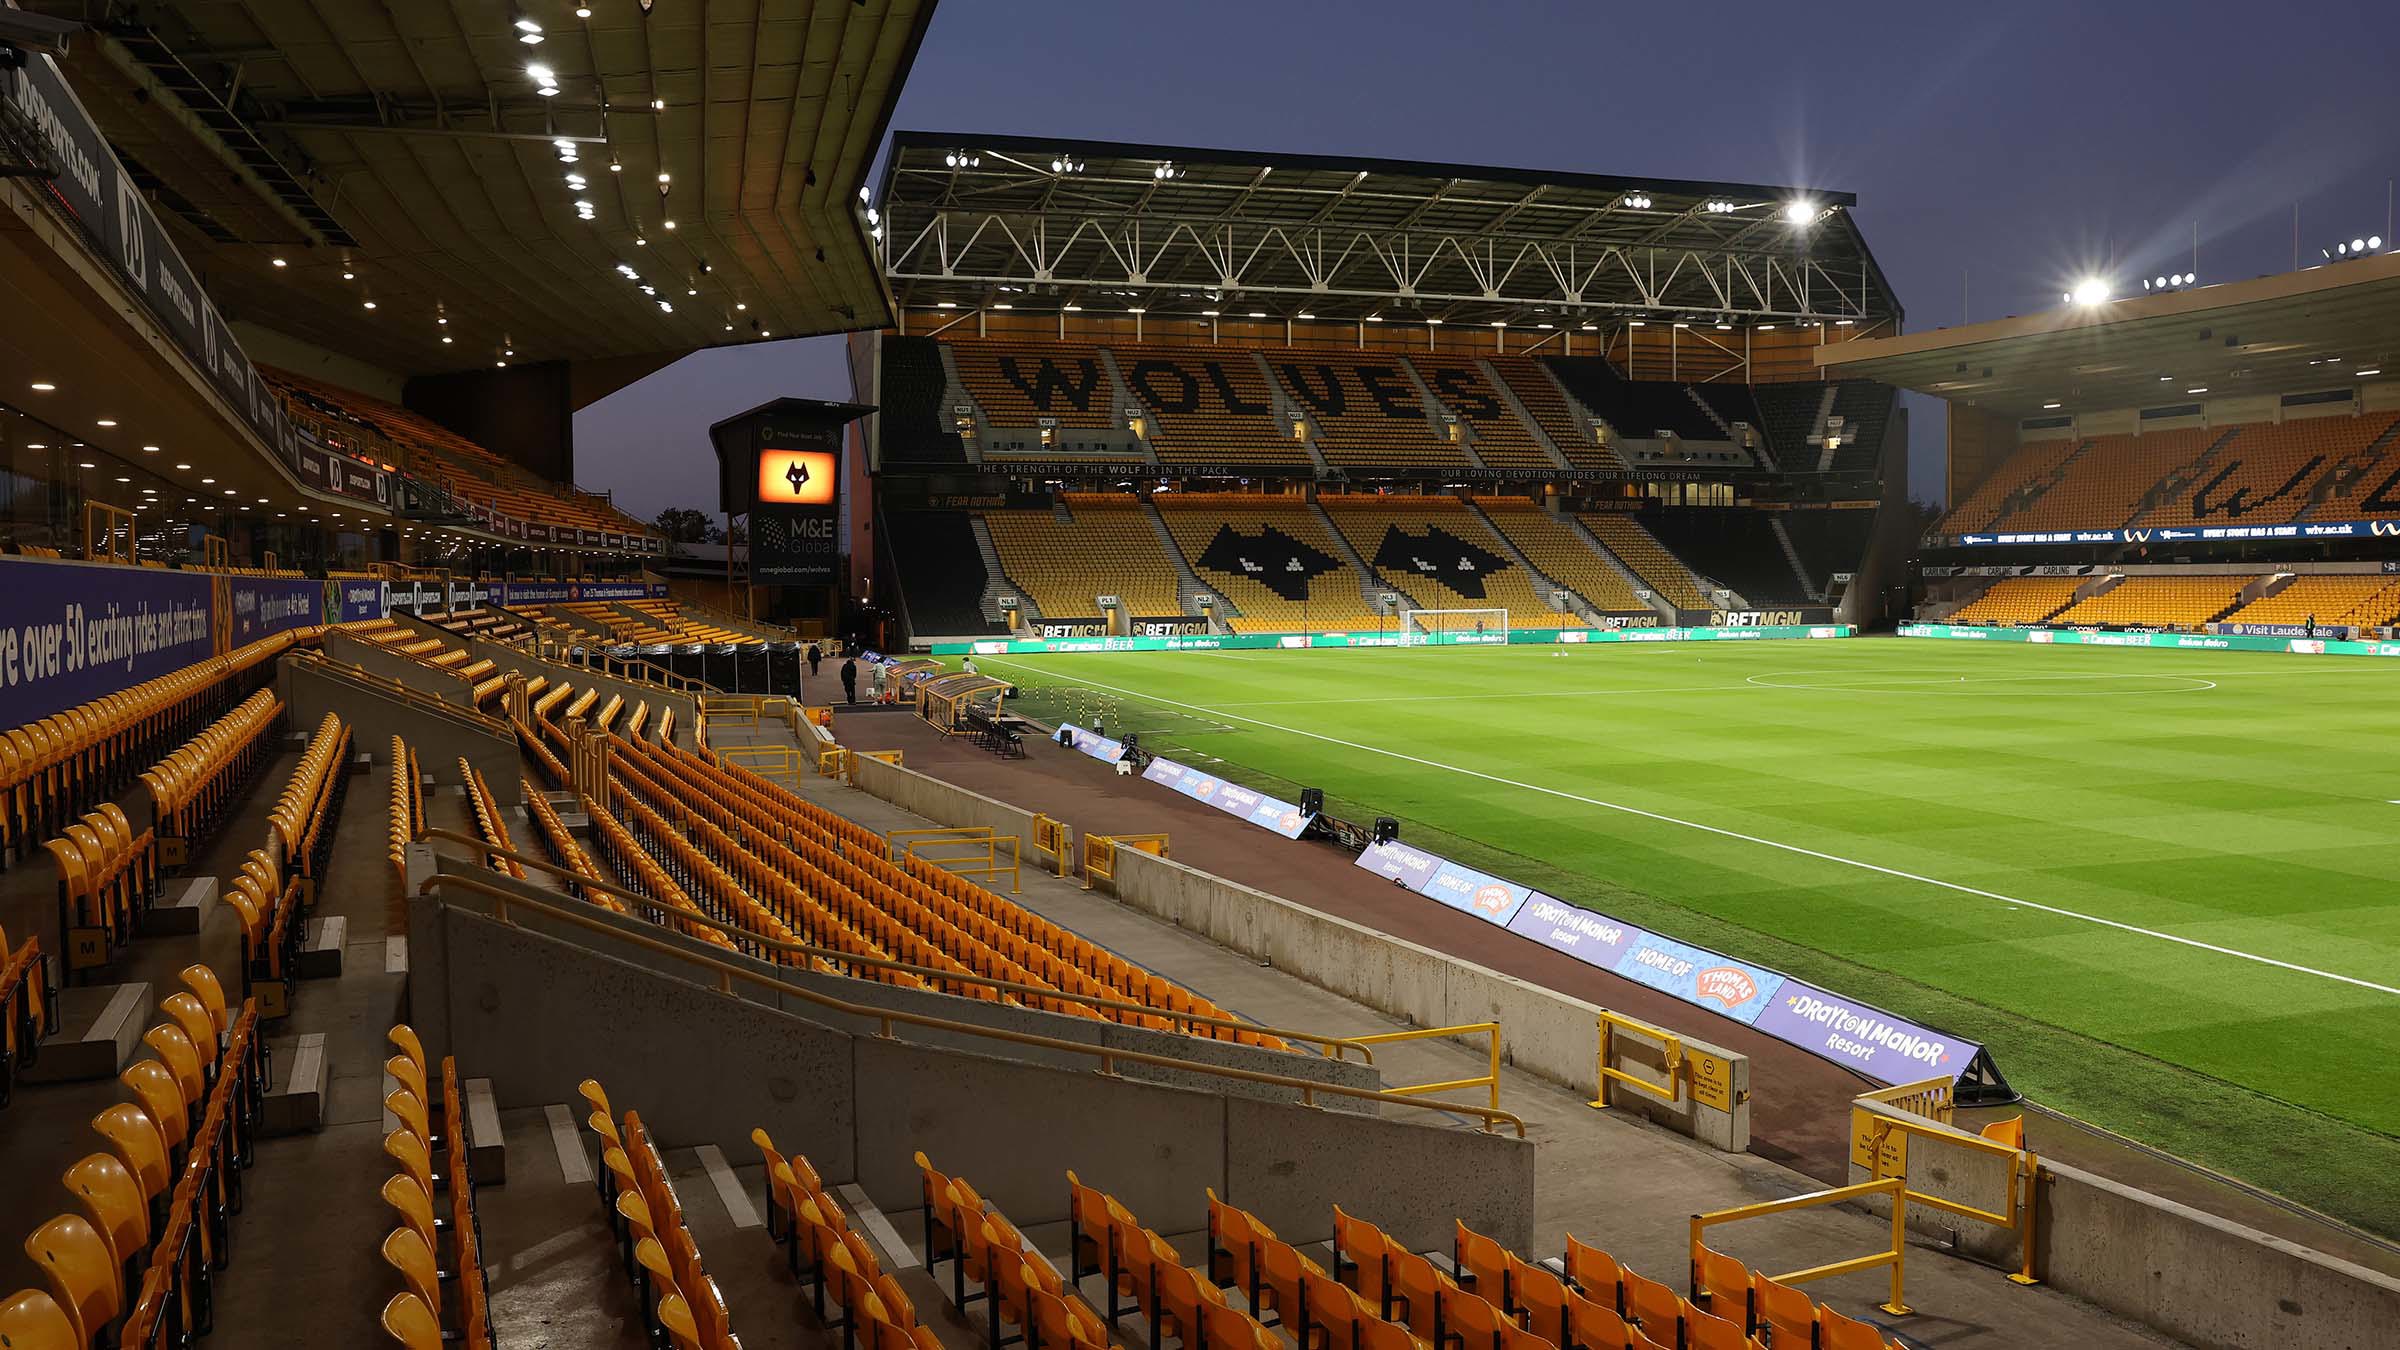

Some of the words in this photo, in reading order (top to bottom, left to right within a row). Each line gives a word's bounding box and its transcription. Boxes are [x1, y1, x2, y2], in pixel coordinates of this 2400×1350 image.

[976, 464, 997, 473] THE
[1002, 465, 1060, 473] STRENGTH
[1065, 465, 1078, 474] OF
[1084, 465, 1104, 474] THE
[1109, 466, 1140, 474] WOLF
[1146, 466, 1156, 474] IS
[1161, 466, 1173, 474] IN
[1178, 466, 1198, 474] THE
[1202, 466, 1228, 475] PACK
[1440, 469, 1461, 477] OUR
[1465, 469, 1502, 478] LOVING
[1506, 470, 1555, 479] DEVOTION
[1560, 471, 1595, 480] GUIDES
[1599, 472, 1618, 480] OUR
[1621, 472, 1666, 480] LIFELONG
[1669, 472, 1700, 480] DREAM
[791, 518, 833, 538] M&E
[790, 538, 835, 553] Global
[1988, 566, 2013, 576] CARLING
[2043, 566, 2070, 575] CARLING
[1606, 616, 1658, 628] BETMGM
[1727, 611, 1802, 626] BETMGM
[1145, 622, 1207, 636] BETMGM
[2245, 624, 2269, 635] Visit
[23, 623, 62, 682] over
[65, 602, 85, 672] 50
[88, 601, 133, 673] exciting
[134, 600, 157, 655] rides
[158, 599, 172, 649] and
[174, 597, 207, 644] attractions
[1104, 638, 1134, 650] BEER
[167, 848, 177, 857] M
[1437, 873, 1461, 893] HOME
[1461, 881, 1475, 896] OF
[1550, 928, 1581, 947] Resort
[81, 942, 95, 954] M
[1635, 948, 1675, 971] HOME
[1672, 960, 1694, 977] OF
[1703, 966, 1755, 998] THOMAS
[1708, 982, 1736, 1001] LAND
[1825, 1032, 1878, 1062] Resort
